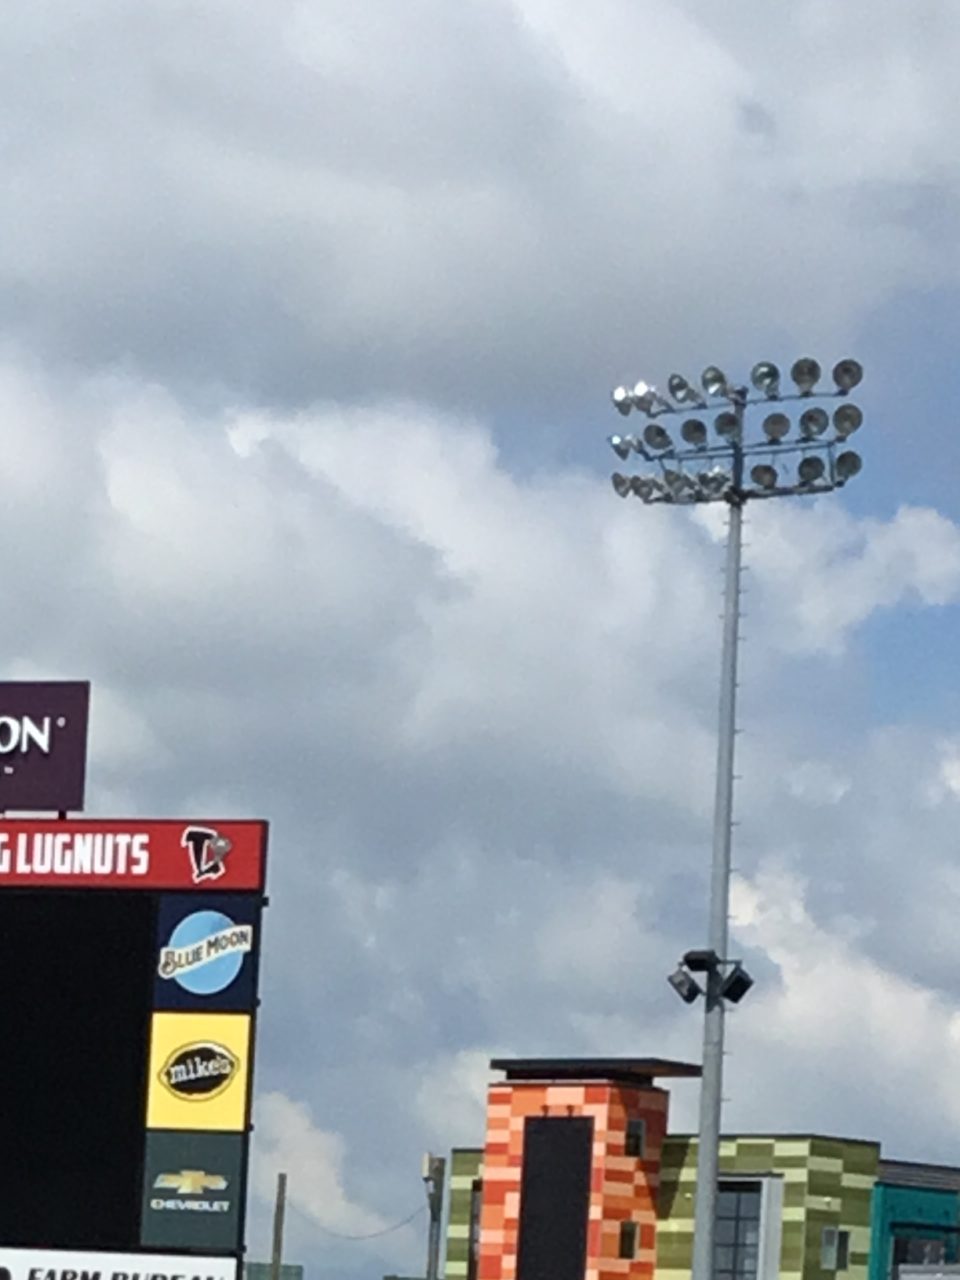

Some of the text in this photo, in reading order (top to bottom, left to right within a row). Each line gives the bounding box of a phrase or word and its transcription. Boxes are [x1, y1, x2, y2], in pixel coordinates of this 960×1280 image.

[16, 833, 149, 875] LUGNUTS
[161, 929, 249, 976] BLUE MOON
[149, 1198, 230, 1212] CHEVROLET
